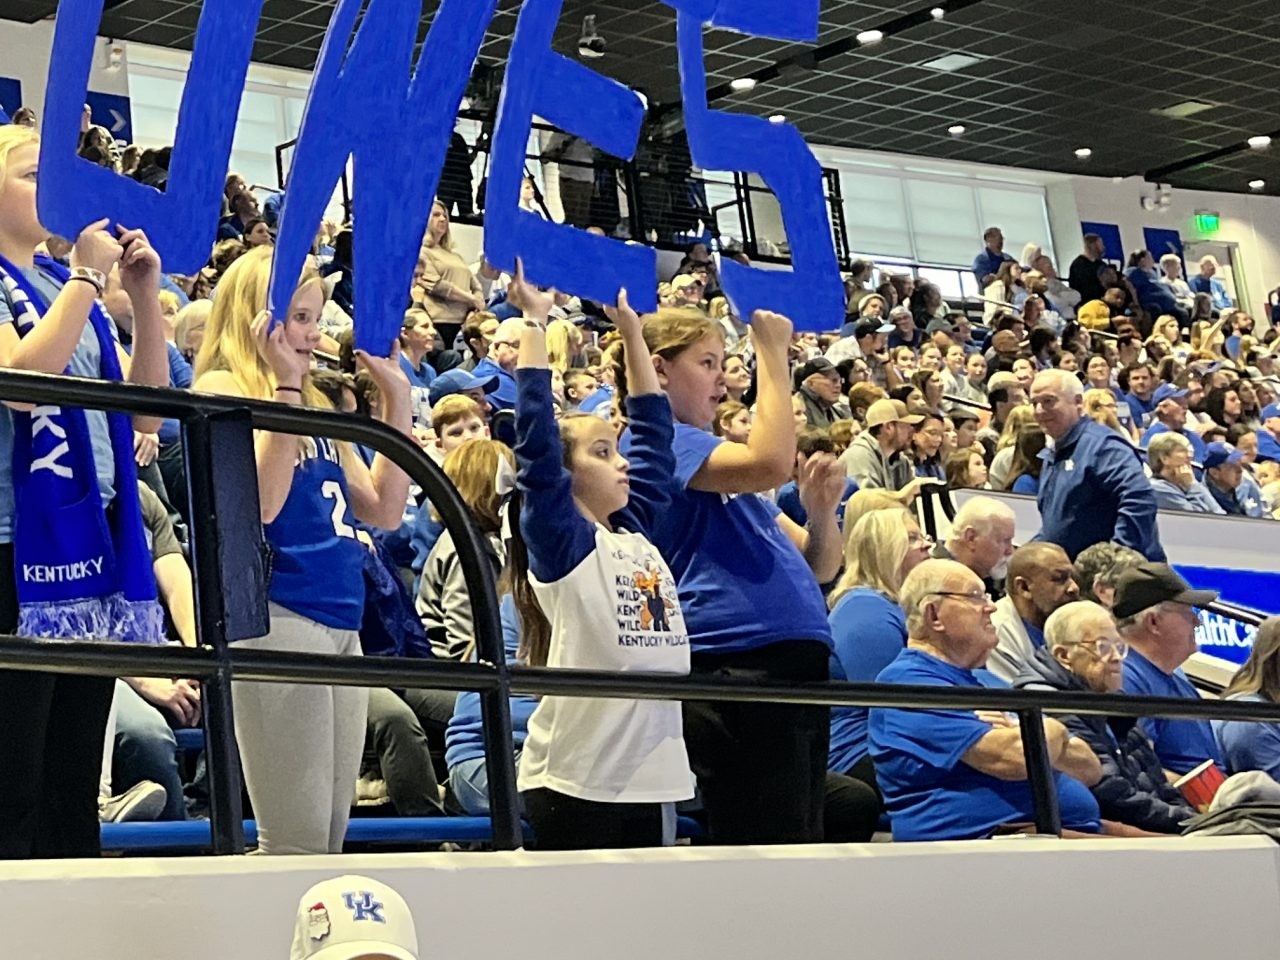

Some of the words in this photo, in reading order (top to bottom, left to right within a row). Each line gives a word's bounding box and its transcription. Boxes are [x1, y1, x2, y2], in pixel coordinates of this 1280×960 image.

[22, 556, 105, 584] KENTUCKY
[618, 634, 663, 648] KENTUCKY
[341, 890, 387, 925] UK
